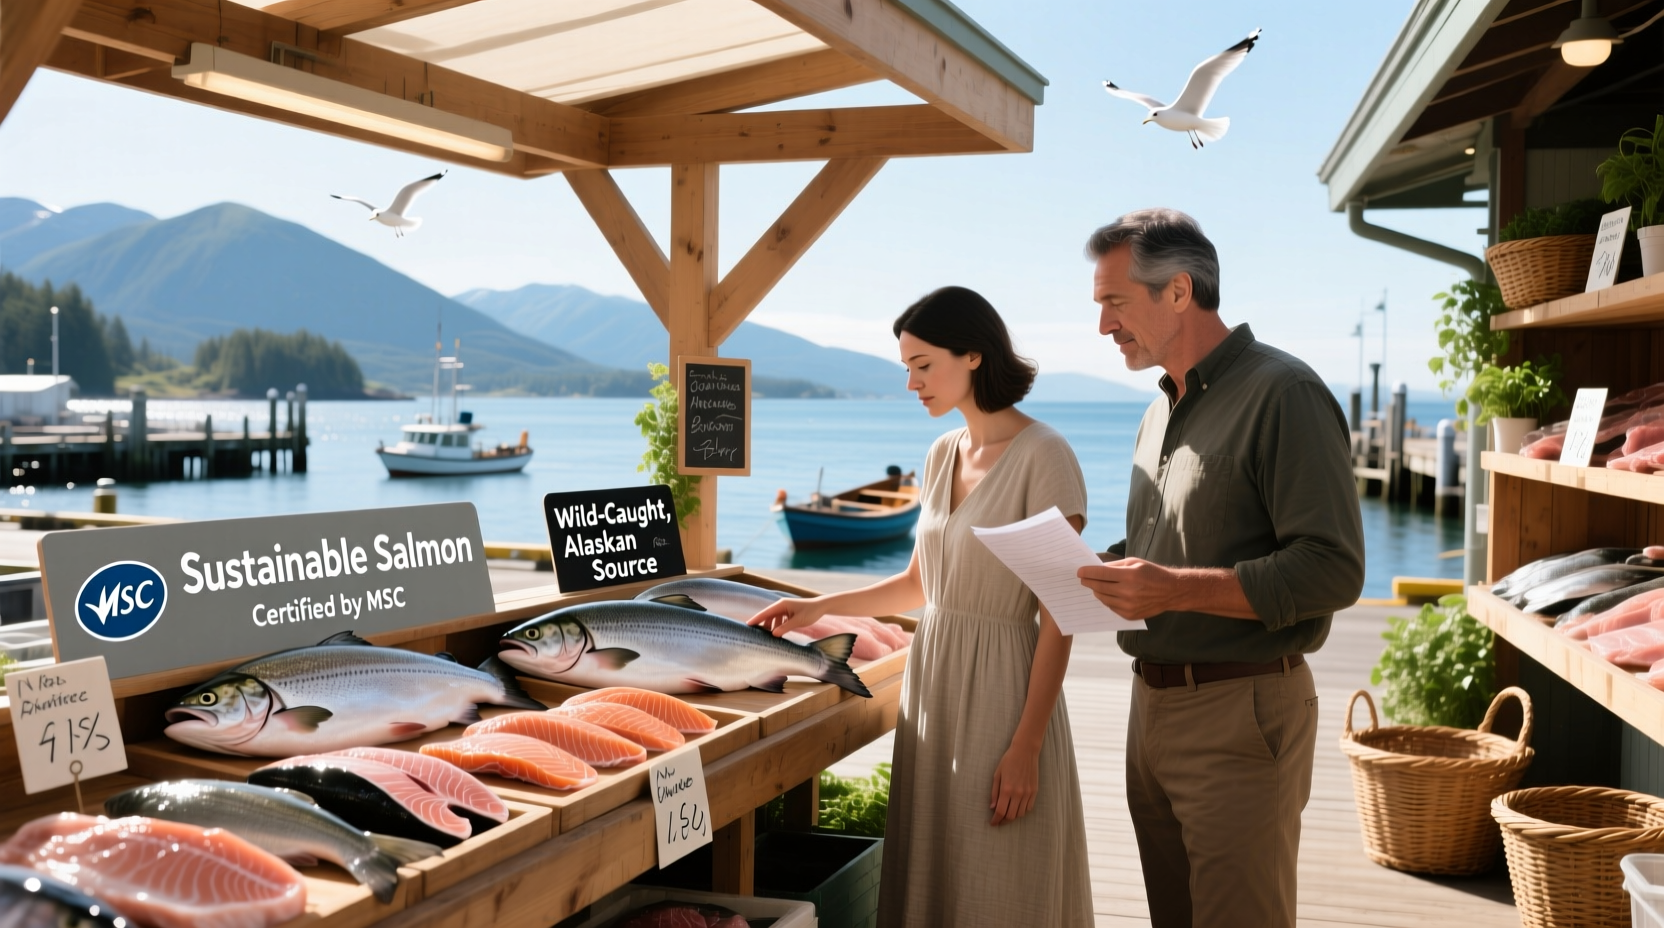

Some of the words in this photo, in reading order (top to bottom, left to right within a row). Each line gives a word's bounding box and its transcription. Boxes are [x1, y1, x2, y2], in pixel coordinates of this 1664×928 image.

[553, 498, 671, 529] Wild-Caught,
[564, 529, 637, 558] Alaskan
[180, 536, 368, 594] Sustainable
[373, 531, 474, 572] Salmon
[591, 556, 658, 581] Source
[85, 580, 155, 626] MSC
[252, 594, 336, 627] Certified
[339, 591, 363, 621] by
[366, 586, 407, 612] MSC
